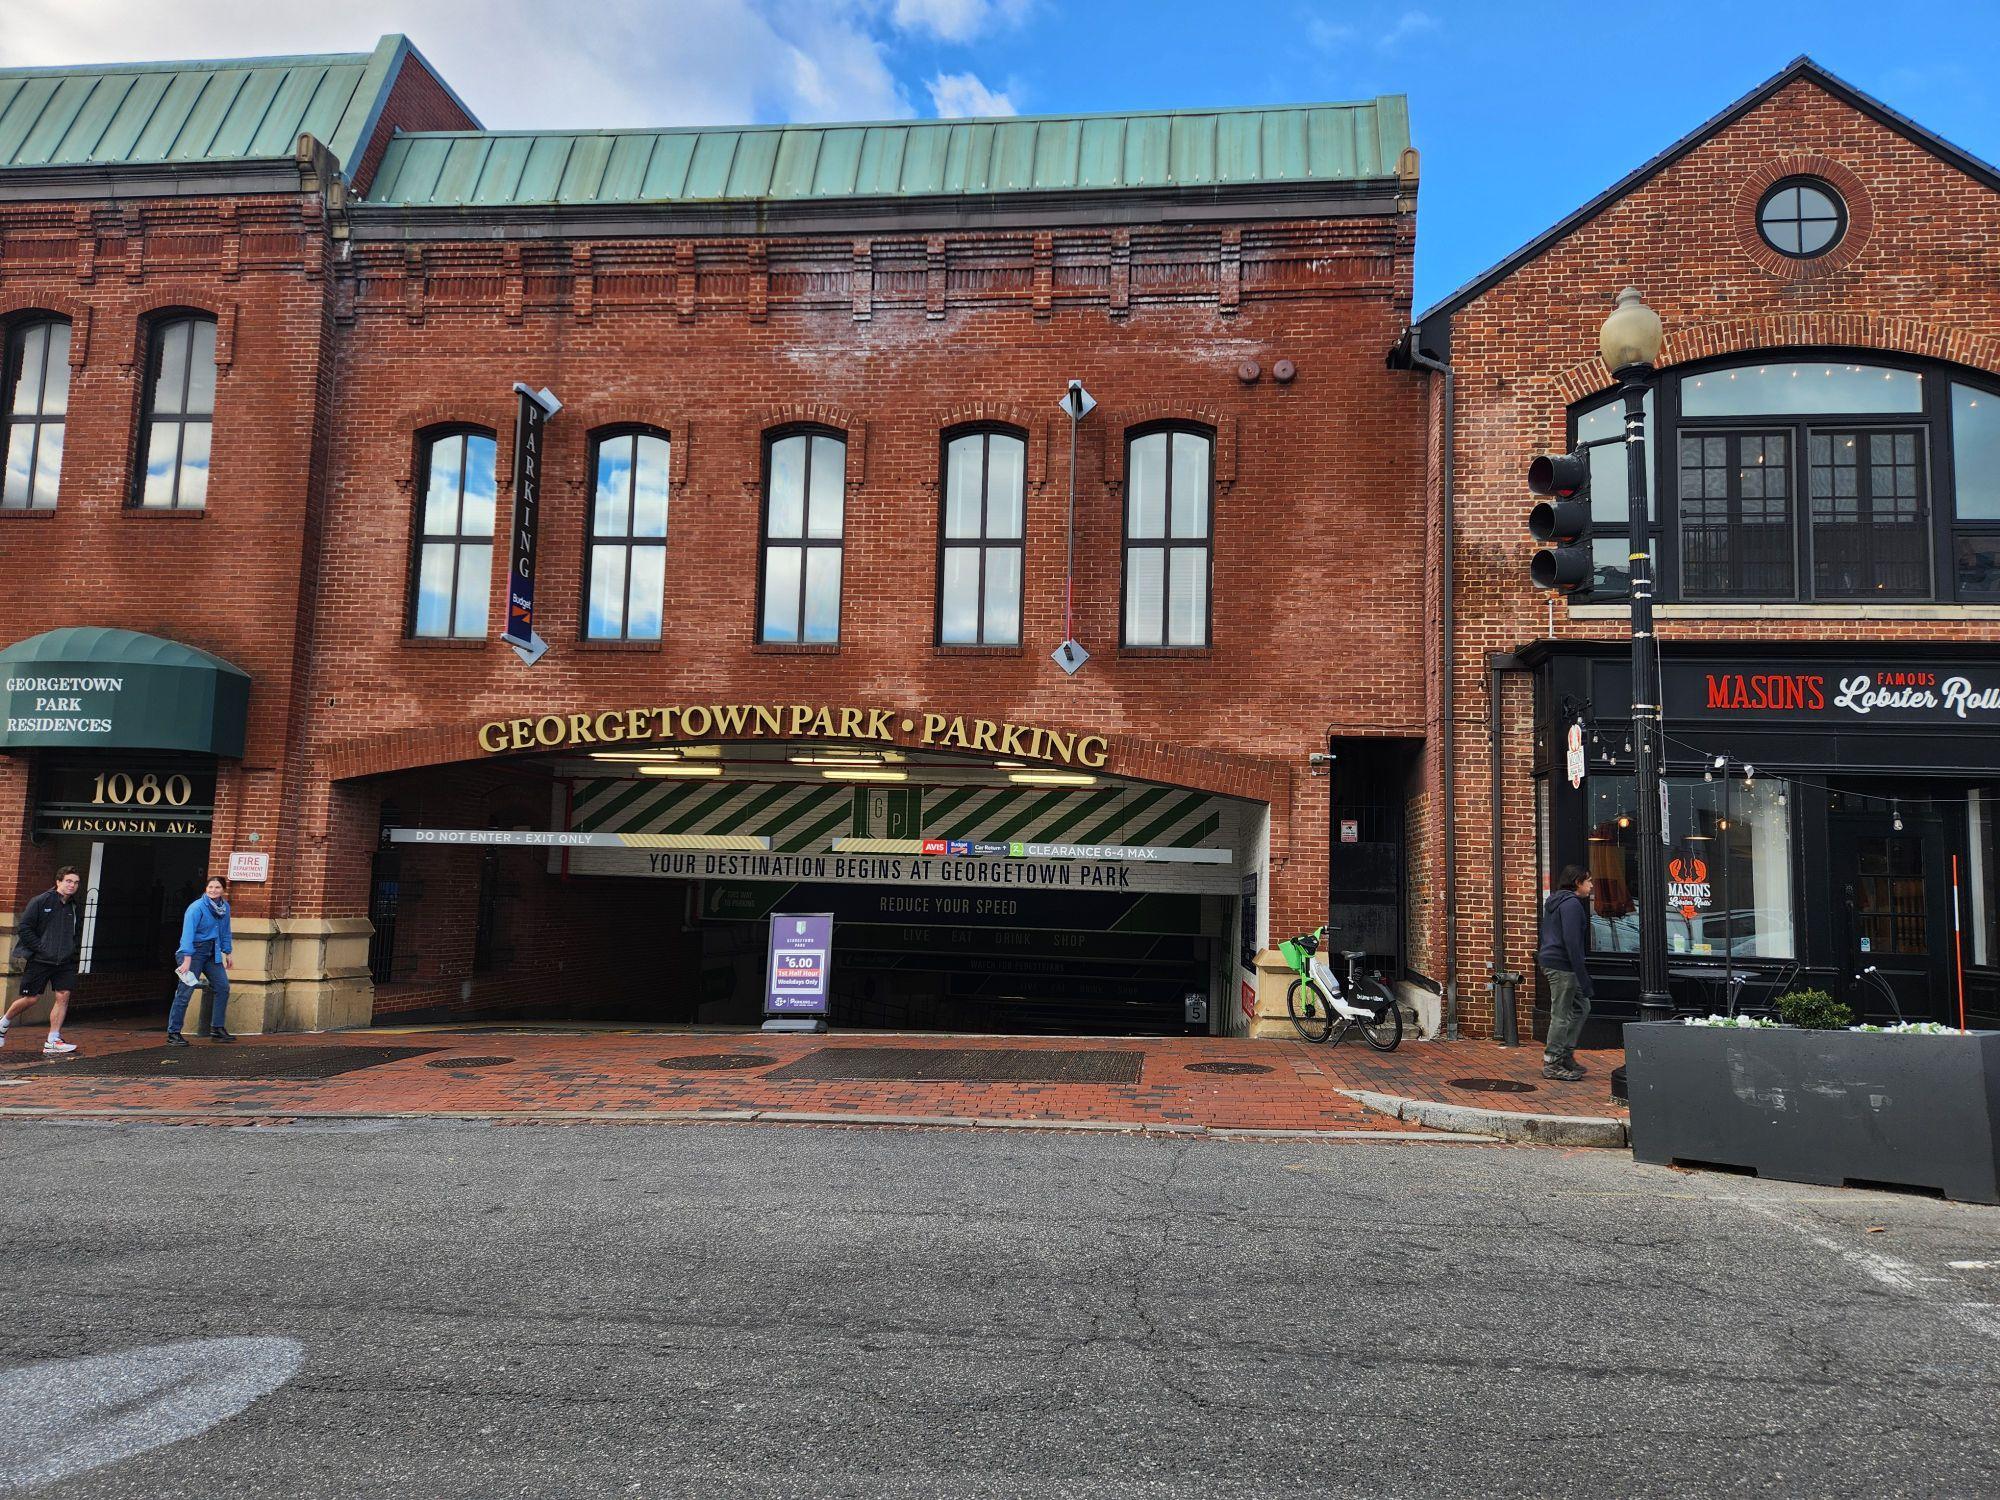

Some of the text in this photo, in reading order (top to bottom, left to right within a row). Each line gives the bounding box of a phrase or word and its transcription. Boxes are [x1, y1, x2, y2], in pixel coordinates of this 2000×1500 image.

[519, 405, 537, 578] PARKING
[512, 593, 531, 610] Budget
[6, 678, 123, 691] GEORGETOWN
[1705, 672, 2000, 719] MASON'S FAMOUS Lobster Roll
[35, 697, 82, 711] PARK
[7, 718, 112, 732] RESIDENCES
[477, 704, 783, 752] GEORGETOWN
[791, 705, 895, 740] PARK
[921, 713, 1109, 768] PARKING
[92, 772, 192, 806] 1080
[61, 818, 203, 834] WISCONSIN AVE.
[416, 831, 435, 841] DO
[439, 832, 465, 841] NOT
[470, 832, 511, 842] ENTER
[525, 833, 554, 843] EXIT
[559, 834, 592, 844] ONLY
[925, 843, 945, 851] AVIS
[1028, 845, 1158, 859] CLEARANCE 6-4 MAX.
[238, 857, 260, 866] FIRE
[650, 853, 1130, 887] YOUR DESTINATION BEGINS AT GEORGETOWN PARK
[1668, 883, 1711, 897] MASON'S
[880, 896, 1017, 916] REDUCE YOUR SPEED
[903, 928, 1087, 947] LIVE EAT DRINK SHOP
[785, 956, 813, 968] $6.00
[1192, 1007, 1201, 1019] 5
